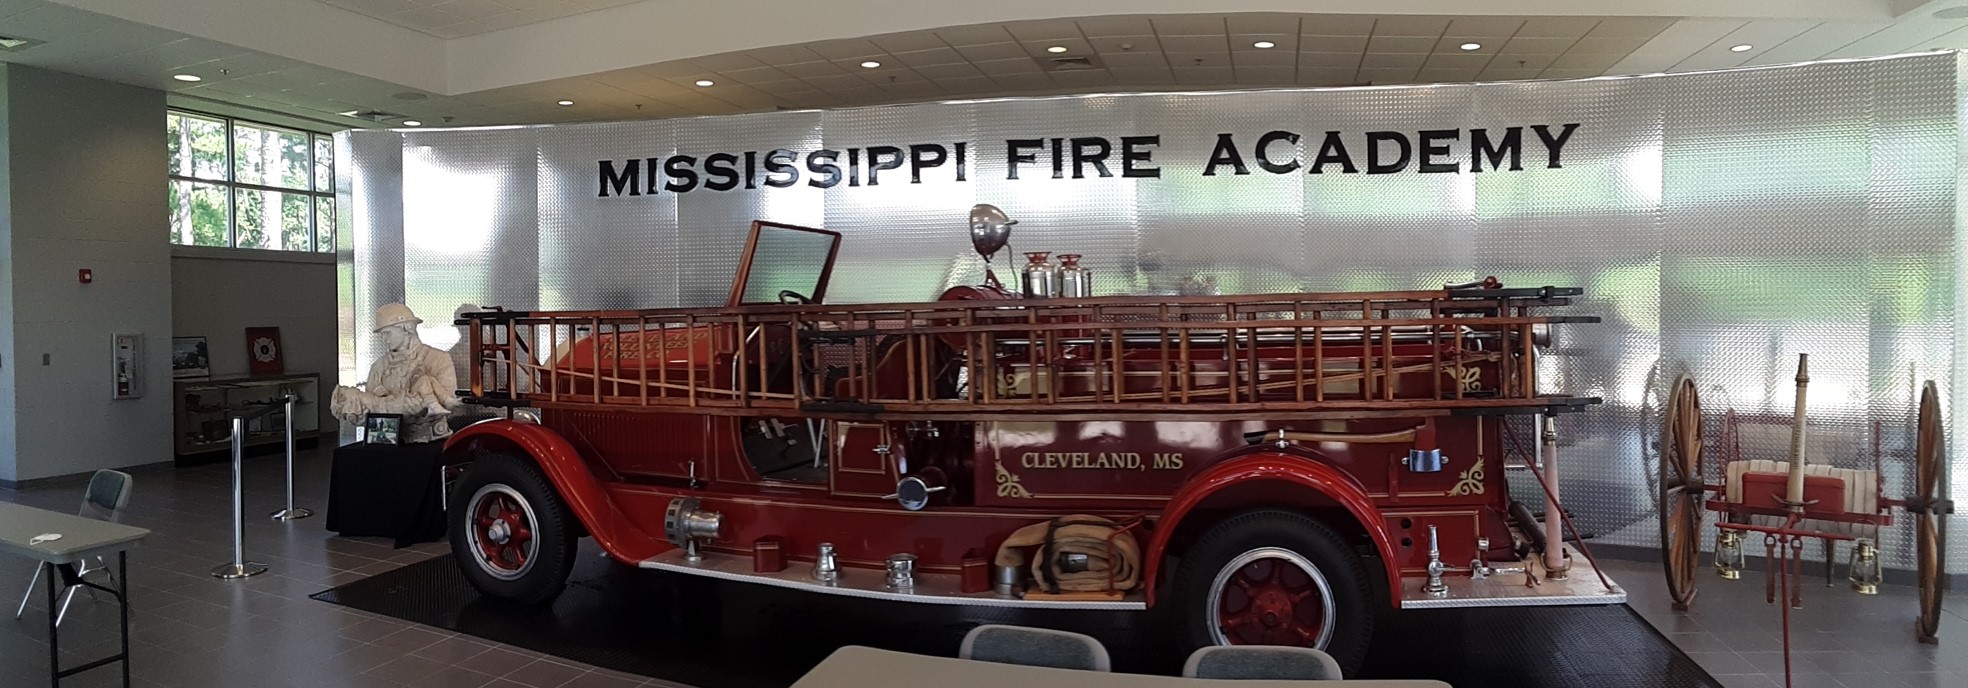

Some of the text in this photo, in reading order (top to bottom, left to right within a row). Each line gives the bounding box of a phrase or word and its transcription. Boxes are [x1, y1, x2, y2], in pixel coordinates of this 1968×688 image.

[598, 123, 1581, 198] MISSISSIPPI FIRE ACADEMY
[1021, 452, 1184, 472] CLEVELAND, MS
